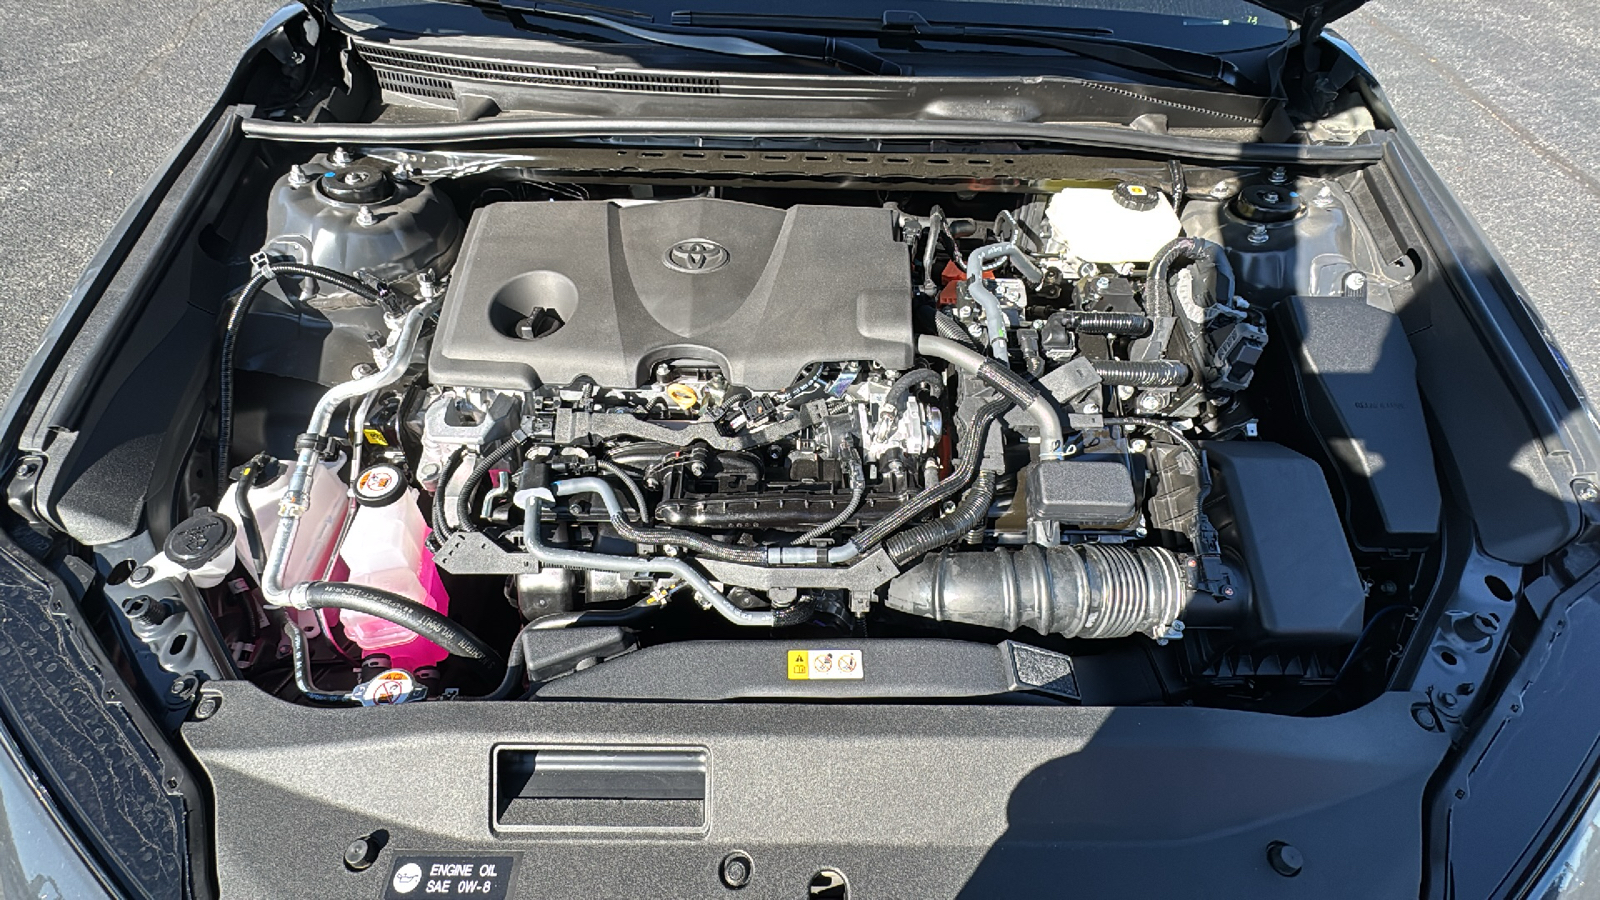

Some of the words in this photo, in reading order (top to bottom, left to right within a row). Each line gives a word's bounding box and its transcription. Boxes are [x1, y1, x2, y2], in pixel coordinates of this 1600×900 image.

[430, 864, 474, 876] ENGINE
[479, 864, 498, 877] OIL
[425, 880, 451, 893] SAE
[457, 880, 491, 893] 0W-8
